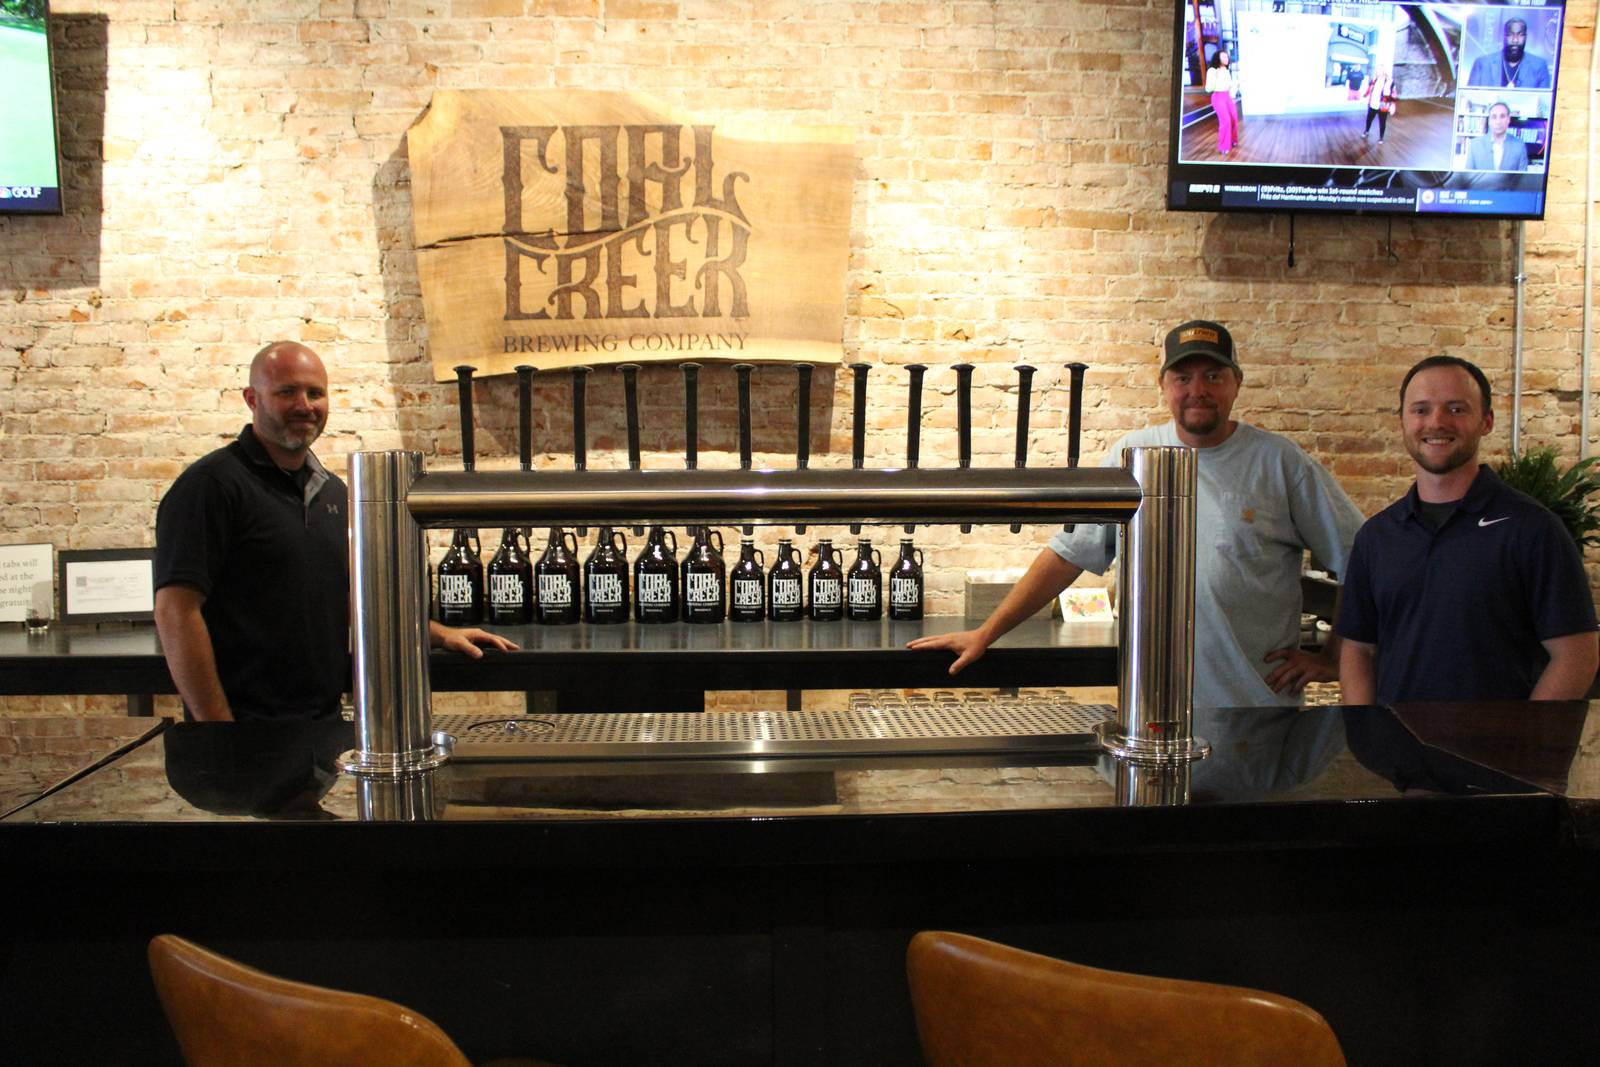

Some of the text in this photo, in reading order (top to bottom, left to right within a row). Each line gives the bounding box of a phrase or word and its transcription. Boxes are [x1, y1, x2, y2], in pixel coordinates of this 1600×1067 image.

[11, 186, 42, 198] GOLF
[500, 125, 752, 250] COAL
[503, 213, 752, 320] CREEK
[503, 332, 750, 354] BREWING COMPANY
